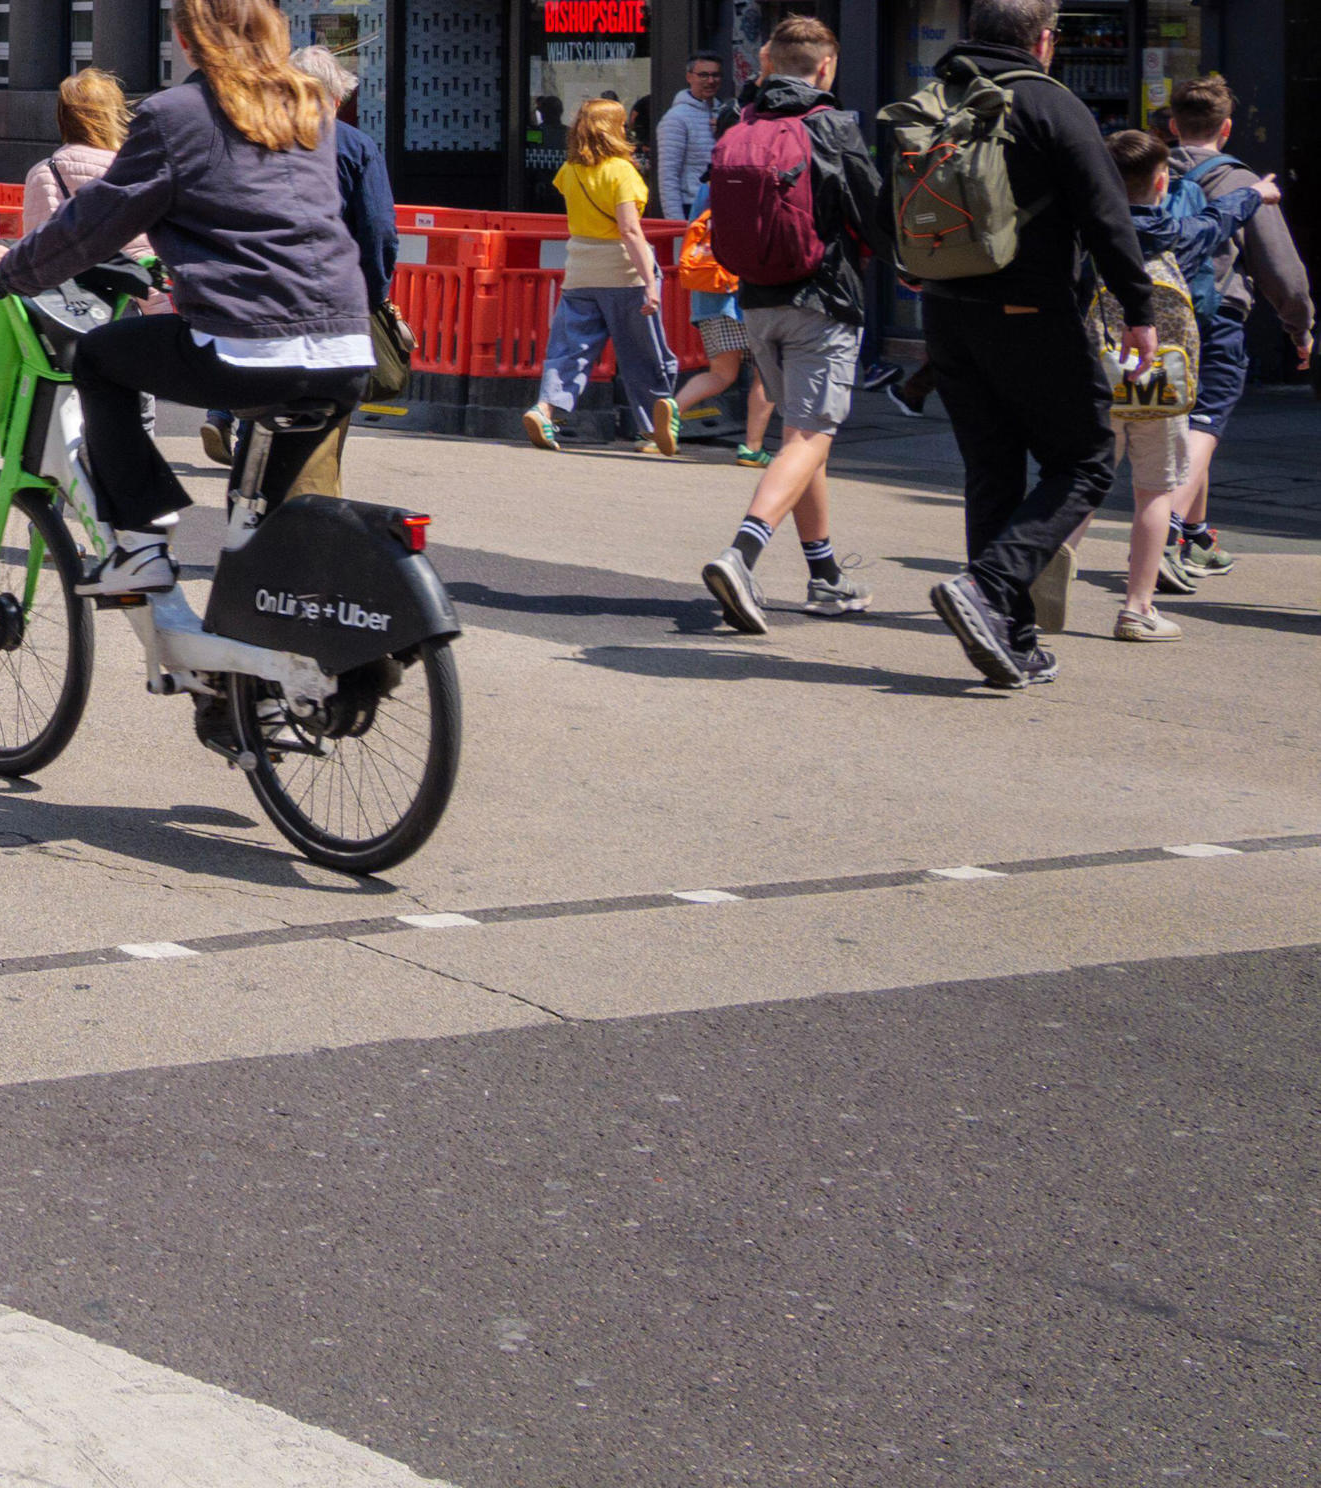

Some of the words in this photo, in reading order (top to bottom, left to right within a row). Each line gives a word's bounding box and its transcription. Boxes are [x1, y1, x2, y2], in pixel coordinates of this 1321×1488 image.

[544, 0, 646, 33] BISHOPSGATE
[547, 41, 583, 64] WHAT'S
[337, 600, 393, 632] Uber
